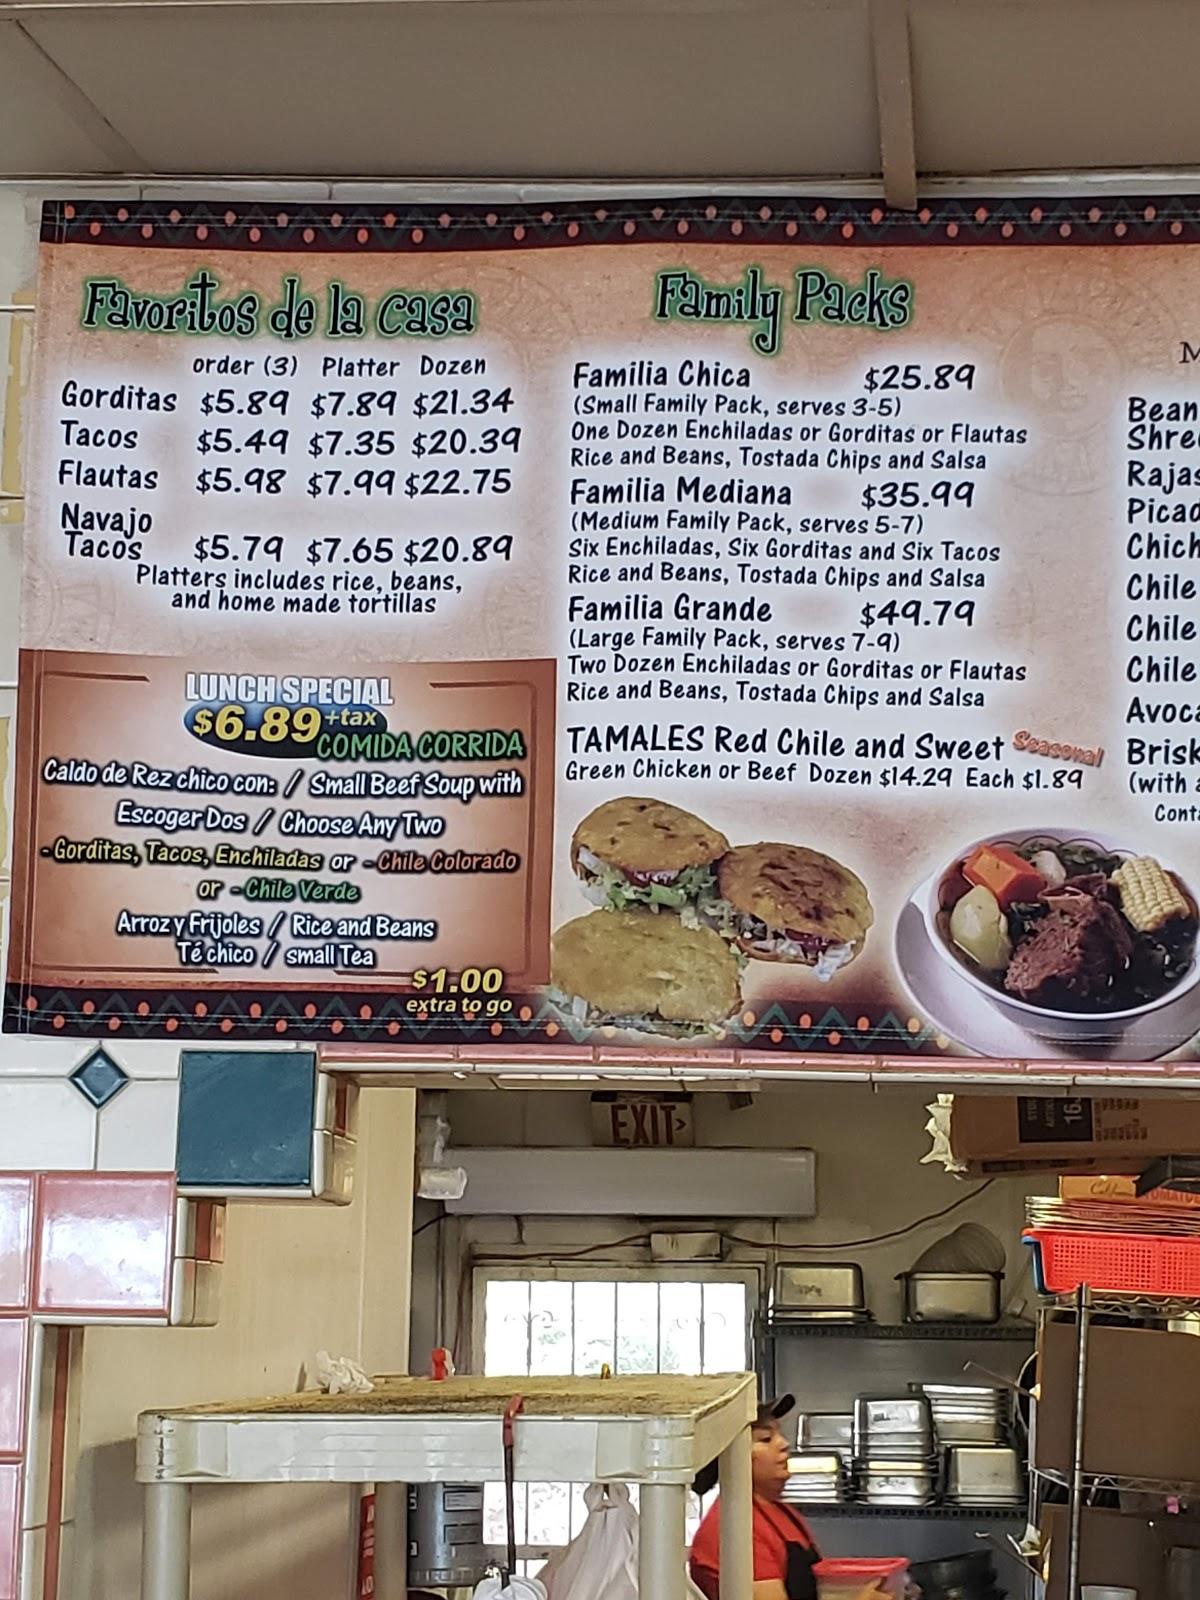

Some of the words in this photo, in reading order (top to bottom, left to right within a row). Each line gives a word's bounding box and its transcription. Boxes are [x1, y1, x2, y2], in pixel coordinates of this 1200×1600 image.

[84, 272, 256, 334] Favoritos
[270, 279, 314, 337] de
[328, 284, 363, 334] la
[378, 293, 474, 333] casa
[657, 268, 781, 354] Family
[795, 270, 910, 327] Packs
[193, 356, 254, 374] order
[264, 356, 297, 376] (3)
[323, 357, 400, 376] Platter
[421, 355, 485, 375] Dozen
[574, 361, 667, 388] Familia
[679, 360, 750, 387] Chica
[864, 364, 975, 393] $25.89
[62, 380, 176, 411] Gorditas
[201, 389, 289, 415] $5.89
[311, 391, 397, 418] $7.89
[413, 388, 514, 418] $21.34
[575, 394, 637, 414] (Small
[645, 393, 707, 415] Family
[716, 394, 768, 417] Pack,
[778, 401, 845, 415] serves
[853, 397, 900, 416] 3-5)
[61, 420, 137, 448] Tacos
[197, 428, 288, 454] $5.49
[309, 431, 394, 458] $7.35
[412, 427, 521, 458] $20.39
[572, 422, 609, 440] One
[618, 420, 677, 438] Dozen
[686, 419, 792, 440] Enchiladas
[800, 427, 821, 441] or
[829, 423, 914, 442] Gorditas
[923, 429, 943, 442] or
[952, 424, 1027, 443] Flautas
[572, 448, 612, 466] Rice
[621, 446, 655, 464] and
[664, 445, 730, 468] Beans,
[740, 447, 818, 467] Tostada
[827, 449, 880, 474] Chips
[889, 451, 924, 468] and
[931, 450, 985, 469] Salsa
[59, 460, 158, 489] Flautas
[196, 468, 286, 494] $5.98
[307, 470, 395, 498] $7.99
[405, 469, 511, 498] $22.75
[571, 477, 664, 505] Familia
[677, 476, 790, 505] Mediana
[862, 481, 974, 510] $35.99
[61, 503, 152, 537] Navajo
[572, 511, 658, 531] (Medium
[667, 510, 730, 532] Family
[738, 512, 791, 534] Pack,
[801, 519, 868, 533] serves
[876, 515, 922, 534] 5-7)
[65, 531, 142, 560] Tacos
[195, 535, 283, 562] $5.79
[307, 538, 393, 565] $7.65
[404, 535, 513, 565] $20.89
[569, 539, 598, 557] Six
[607, 536, 720, 558] Enchiladas,
[729, 538, 758, 556] Six
[766, 538, 851, 559] Gorditas
[860, 542, 895, 560] and
[903, 542, 932, 560] Six
[941, 541, 1000, 561] Tacos
[137, 564, 226, 587] Platters
[235, 569, 324, 590] includes
[333, 571, 382, 593] rice,
[392, 571, 461, 596] beans,
[1127, 574, 1196, 600] Chile
[172, 590, 210, 608] and
[219, 590, 275, 611] home
[284, 593, 340, 612] made
[349, 593, 436, 613] tortillas
[569, 594, 662, 622] Familia
[674, 593, 771, 621] Grande
[861, 600, 975, 628] $49.79
[570, 629, 634, 651] (Large
[643, 627, 706, 649] Family
[714, 628, 768, 650] Pack,
[777, 635, 844, 650] serves
[853, 633, 899, 652] 7-9)
[1127, 615, 1196, 641] Chile
[1127, 656, 1196, 682] Chile
[186, 674, 279, 703] LUNCH
[283, 677, 394, 705] SPECIAL
[192, 706, 321, 742] $6.89
[323, 710, 377, 727] +tax
[316, 734, 411, 758] COMIDA
[418, 732, 523, 758] CORRIDA
[567, 725, 704, 753] TAMALES
[716, 726, 767, 752] Red
[778, 728, 844, 756] Chile
[855, 734, 904, 758] and
[915, 733, 1004, 760] Sweet
[1011, 730, 1105, 767] Seasonal
[44, 761, 98, 783] Caldo
[102, 762, 127, 783] de
[132, 764, 171, 786] Rez
[177, 767, 228, 790] chico
[233, 772, 276, 793] con:
[310, 774, 366, 795] Small
[370, 775, 419, 795] Beef
[423, 775, 475, 799] Soup
[479, 772, 521, 794] with
[566, 761, 624, 780] Green
[634, 759, 710, 778] Chicken
[719, 765, 740, 779] or
[749, 761, 796, 781] Beef
[810, 763, 871, 784] Dozen
[880, 767, 952, 787] $14.29
[967, 768, 1013, 787] Each
[1023, 770, 1083, 789] $1.89
[1130, 772, 1186, 793] (with
[117, 803, 202, 831] Escoger
[206, 809, 245, 831] Dos
[280, 813, 353, 835] Choose
[358, 814, 398, 839] Any
[402, 813, 443, 835] Two
[1155, 803, 1200, 822] Cont
[42, 839, 138, 864] -Gorditas,
[145, 841, 209, 865] Tacos,
[216, 846, 321, 869] Enchiladas
[331, 853, 353, 869] or
[364, 852, 425, 871] -Chile
[430, 852, 516, 870] Colorado
[199, 881, 220, 897] or
[231, 878, 294, 899] -Chile
[299, 881, 359, 901] Verde
[116, 912, 170, 934] Arroz
[174, 918, 185, 937] y
[189, 913, 260, 939] Frijoles
[292, 915, 333, 937] Rice
[337, 916, 372, 937] and
[376, 916, 434, 938] Beans
[178, 943, 203, 964] Té
[206, 944, 254, 965] chico
[286, 945, 334, 965] small
[339, 944, 374, 965] Tea
[412, 969, 502, 993] $1.00
[406, 997, 456, 1013] extra
[461, 998, 481, 1013] to
[486, 999, 512, 1016] go
[611, 1104, 676, 1145] EXIT
